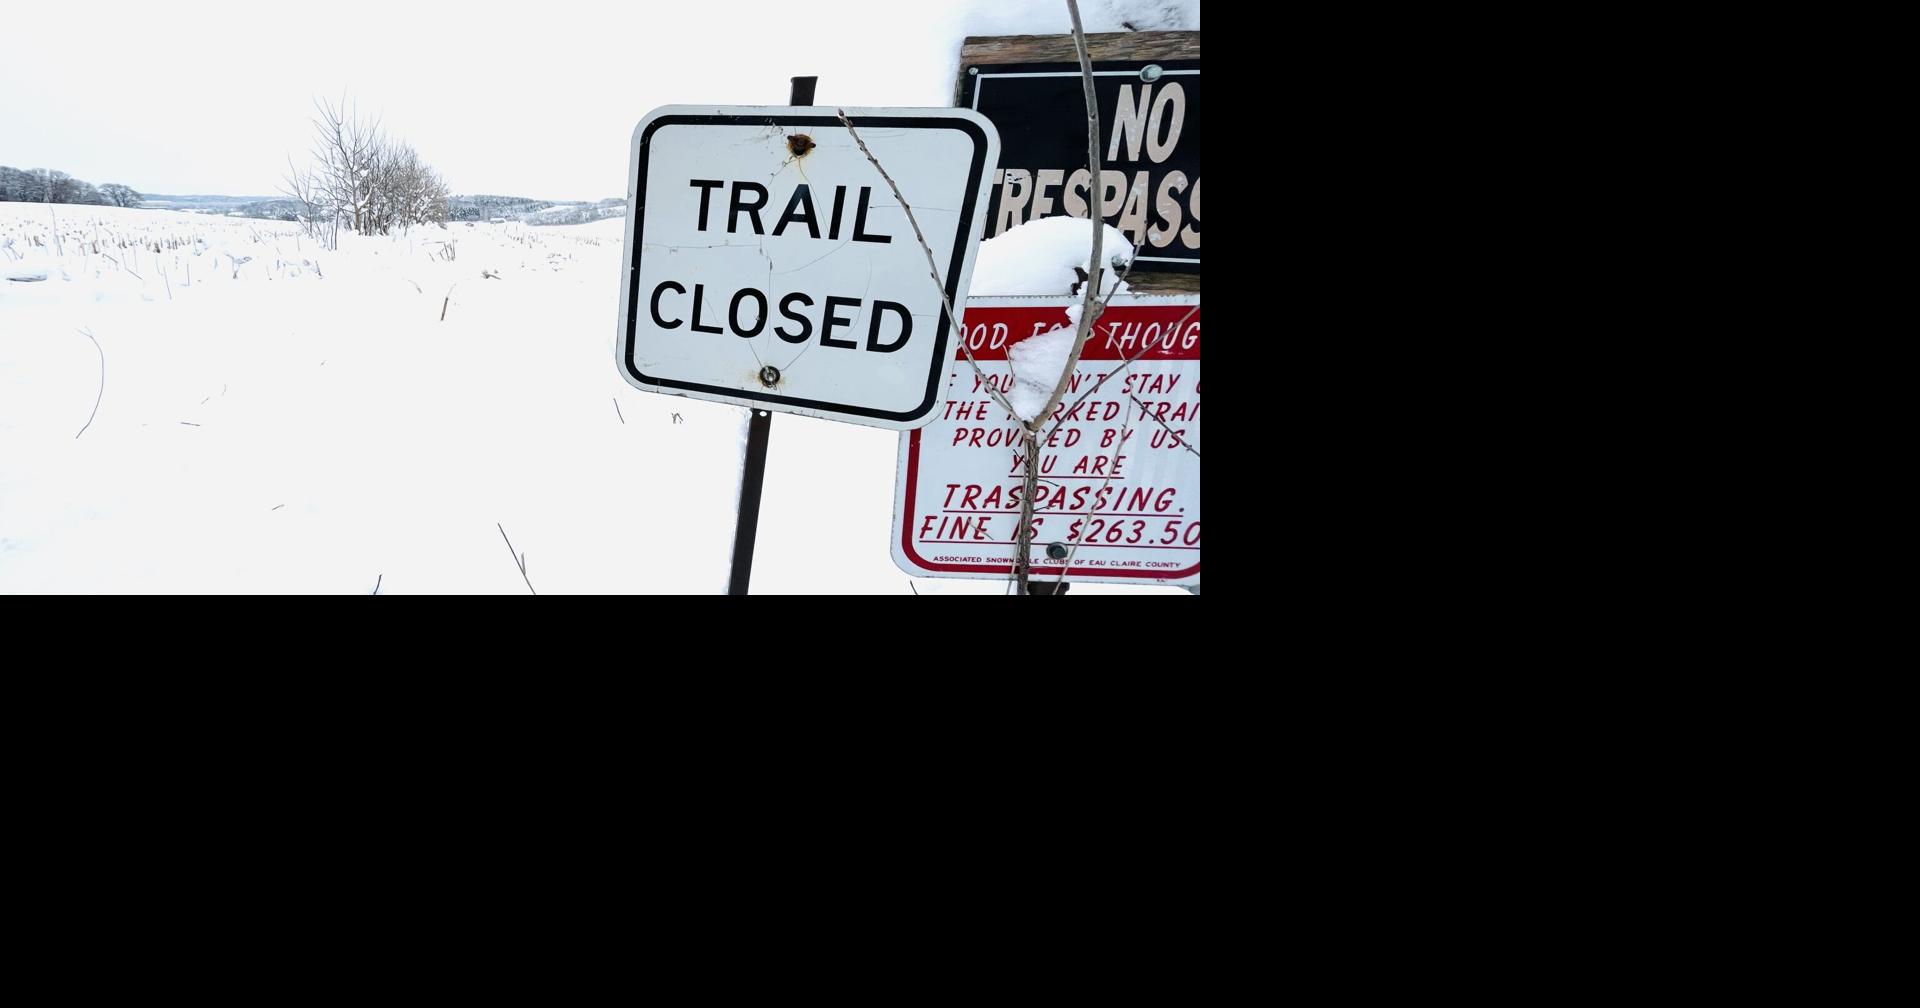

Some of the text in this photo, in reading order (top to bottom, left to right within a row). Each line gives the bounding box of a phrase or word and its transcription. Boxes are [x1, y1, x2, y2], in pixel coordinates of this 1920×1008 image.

[1107, 82, 1186, 163] NO
[689, 179, 892, 243] TRAIL
[650, 280, 913, 353] CLOSED
[1122, 374, 1181, 394] STAY
[943, 401, 990, 420] THE
[952, 428, 1081, 448] PROVIED
[1100, 429, 1133, 448] BY
[1010, 455, 1126, 475] YU ARE
[943, 484, 1184, 512] TRASPASSING.
[919, 516, 992, 540] FINE
[1067, 519, 1200, 545] $263.50
